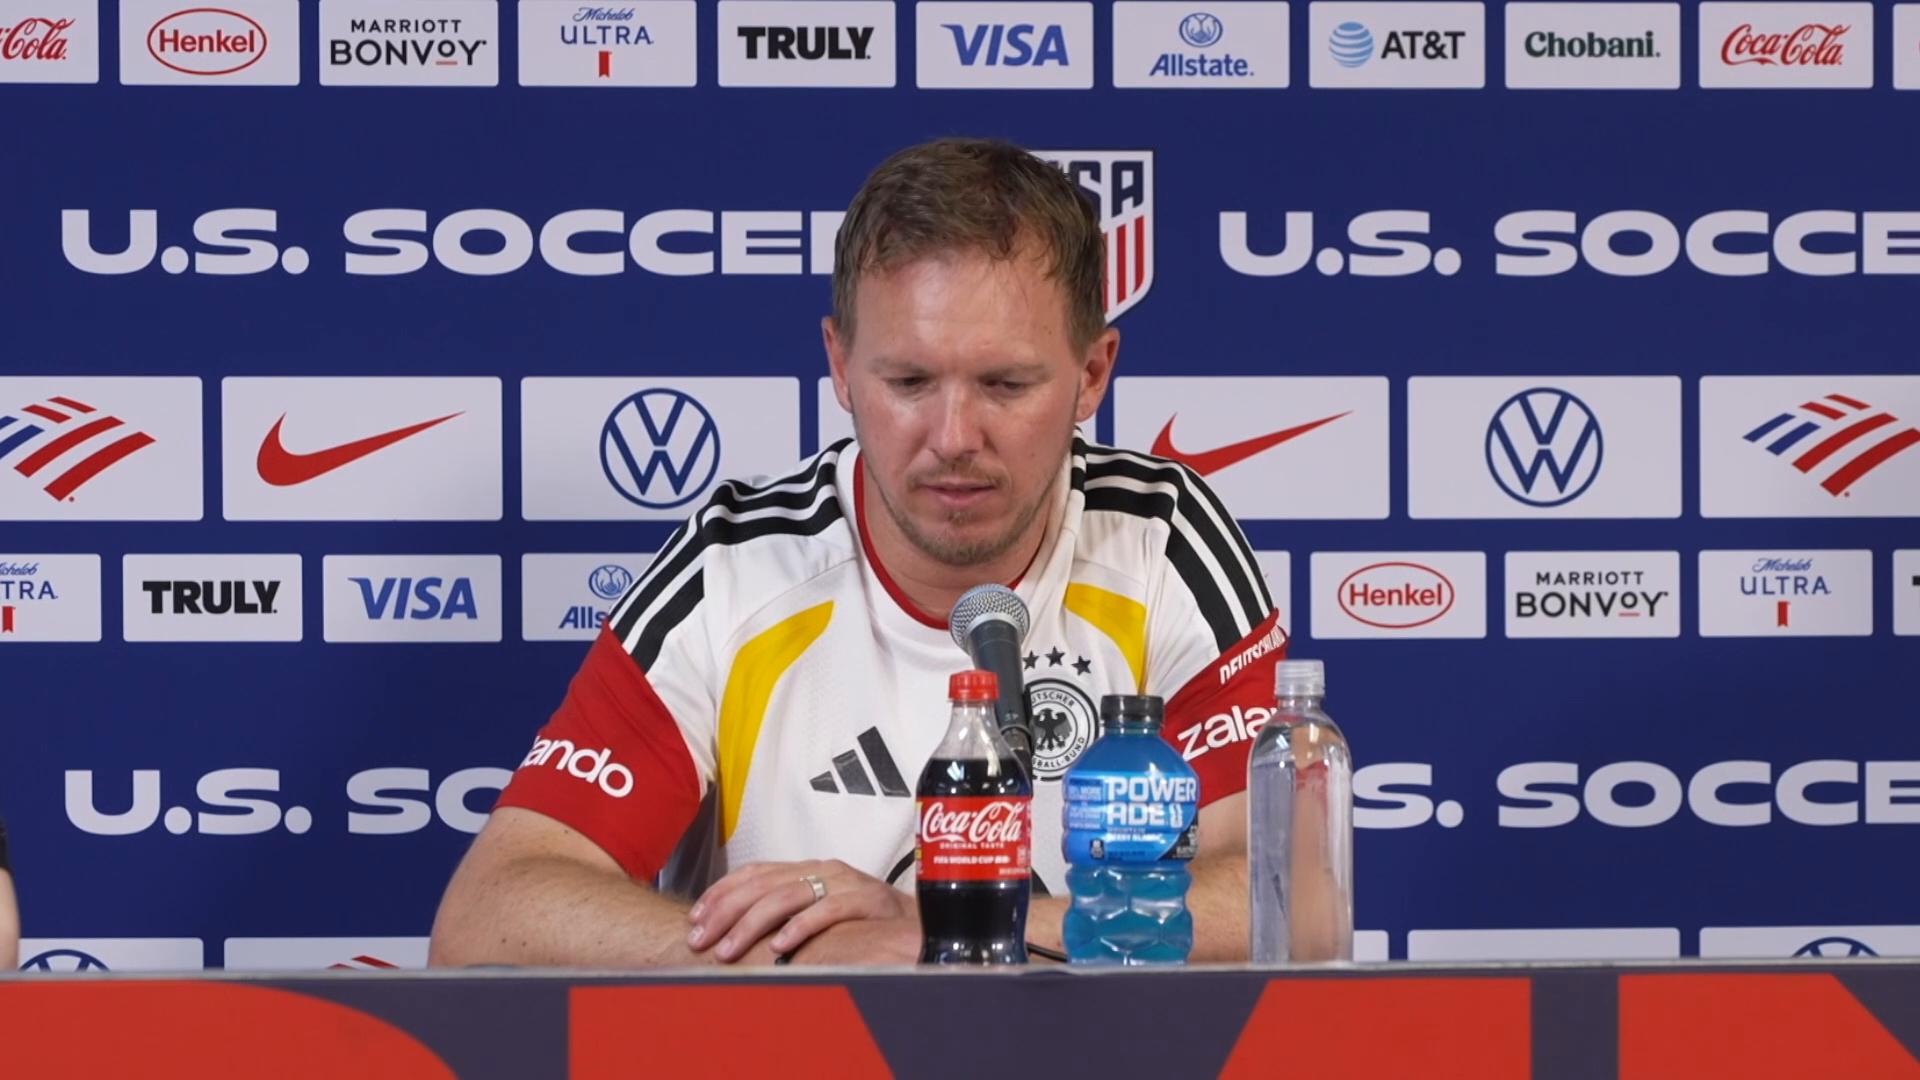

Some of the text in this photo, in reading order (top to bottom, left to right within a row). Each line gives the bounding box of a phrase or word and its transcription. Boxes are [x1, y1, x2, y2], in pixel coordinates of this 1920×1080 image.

[351, 19, 462, 33] MARRIOTT
[573, 7, 635, 22] Michelob
[159, 29, 255, 53] Henkel
[561, 26, 652, 45] ULTRA
[738, 27, 873, 60] TRULY
[941, 24, 1069, 66] VISA
[1381, 31, 1466, 60] AT&T
[1721, 24, 1851, 66] Coca-Cola
[330, 39, 483, 66] BONVOY
[1047, 160, 1144, 224] SA
[62, 208, 309, 275] U.S.
[1219, 210, 1462, 276] U.S.
[1536, 571, 1644, 585] MARRIOTT
[1752, 559, 1812, 573] Michelob
[0, 580, 56, 600] TRA
[142, 580, 278, 614] TRULY
[348, 577, 478, 620] VISA
[1349, 584, 1444, 607] Henkel
[1740, 575, 1829, 595] ULTRA
[559, 605, 609, 629] Alls
[1516, 592, 1664, 618] BONVOY
[1177, 705, 1277, 762] zala
[519, 735, 634, 798] ando
[64, 767, 312, 835] U.S.
[1105, 777, 1196, 802] POWER
[1353, 762, 1464, 829] S.
[922, 801, 1024, 843] Coca-Cola
[1107, 802, 1165, 826] ADE
